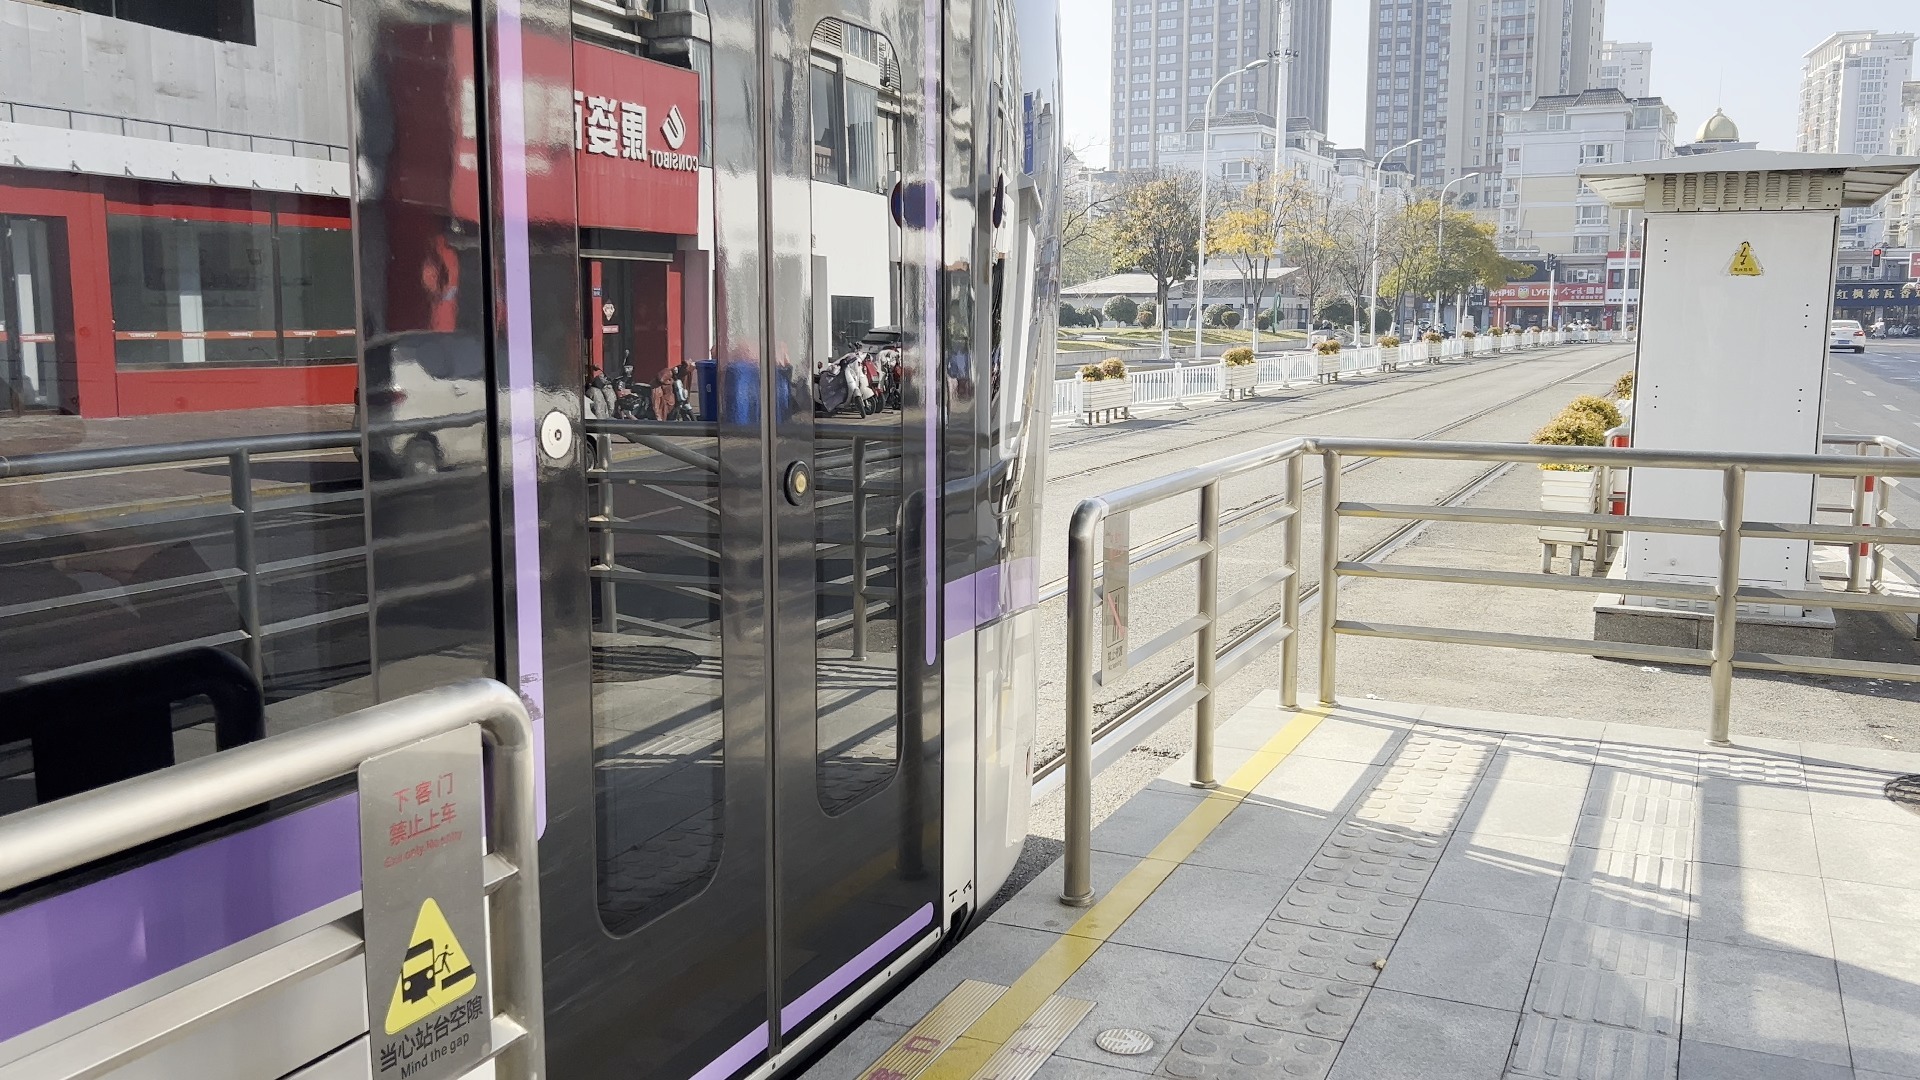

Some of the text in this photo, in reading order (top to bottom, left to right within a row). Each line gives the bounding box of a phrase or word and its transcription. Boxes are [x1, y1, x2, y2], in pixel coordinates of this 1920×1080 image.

[392, 772, 454, 813] 下客门
[389, 803, 457, 847] 禁止上车
[380, 995, 484, 1073] 当心站台空隙
[401, 1032, 470, 1080] Mind the gap
